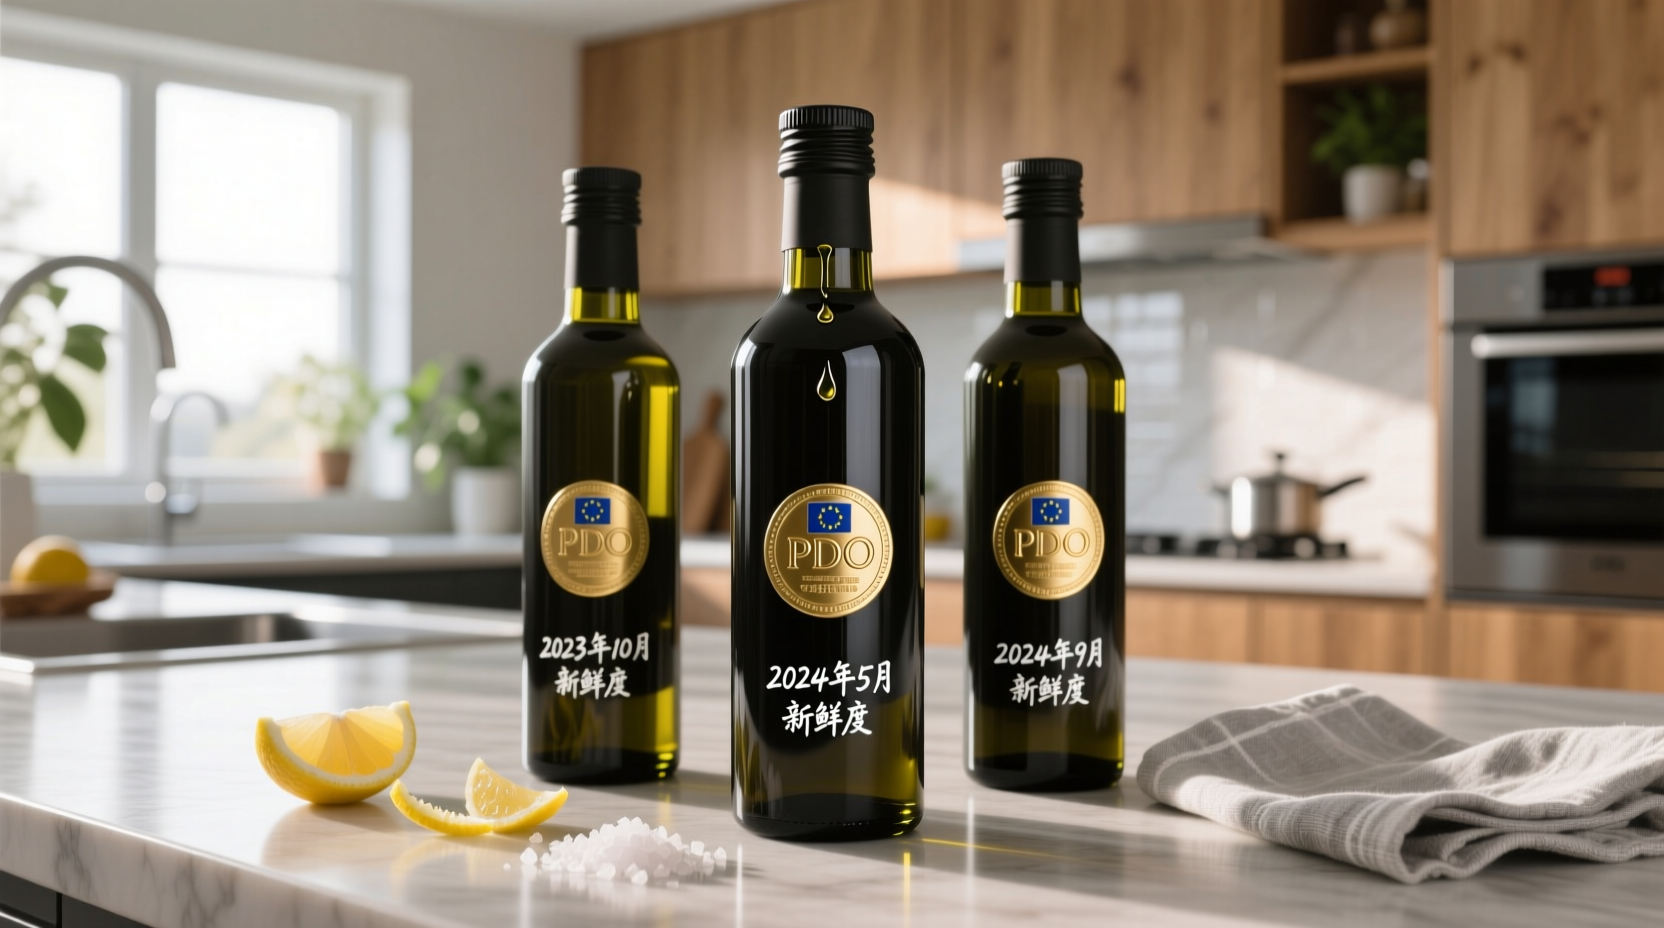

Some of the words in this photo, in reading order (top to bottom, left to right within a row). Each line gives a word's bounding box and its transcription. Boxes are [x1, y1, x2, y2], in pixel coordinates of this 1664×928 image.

[558, 527, 632, 557] PDO
[786, 536, 875, 570] PDO
[1013, 527, 1090, 558] PDO
[539, 631, 648, 664] 2023年10月
[993, 637, 1102, 670] 2024年9月
[554, 665, 630, 699] 新鲜度
[765, 659, 890, 697] 2024年5月
[1009, 672, 1089, 706] 新鲜度
[781, 699, 872, 737] 新鲜度
